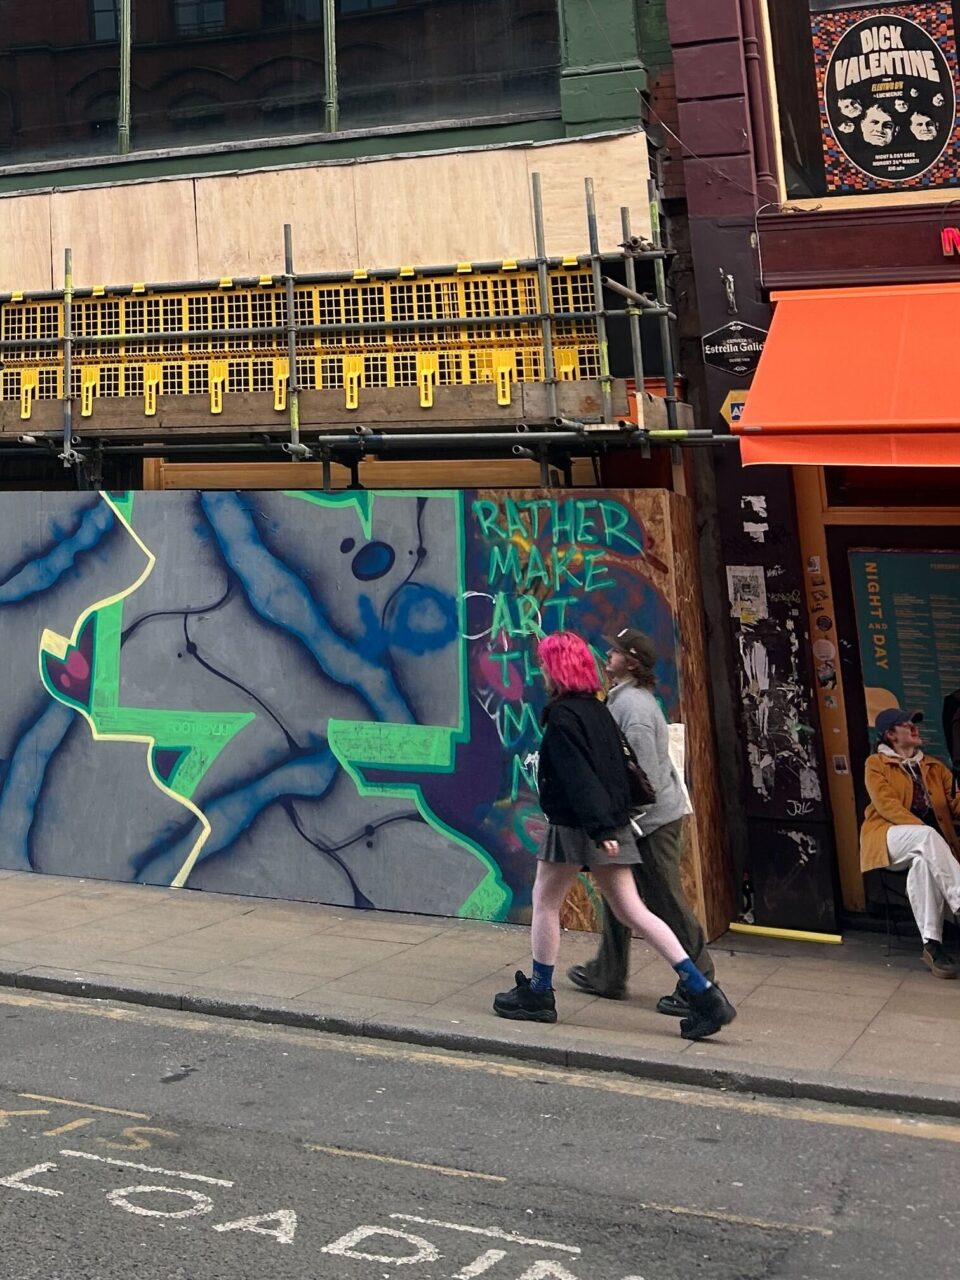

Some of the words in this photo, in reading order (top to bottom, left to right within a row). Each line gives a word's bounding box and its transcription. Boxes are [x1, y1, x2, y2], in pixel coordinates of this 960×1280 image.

[860, 24, 905, 54] DICK
[834, 50, 941, 92] VALENTINE
[704, 344, 739, 354] Estrella
[472, 496, 648, 561] RATHER
[488, 543, 616, 592] MAKE
[864, 561, 883, 619] NIGHT
[491, 591, 580, 640] ART
[873, 634, 889, 670] DAY
